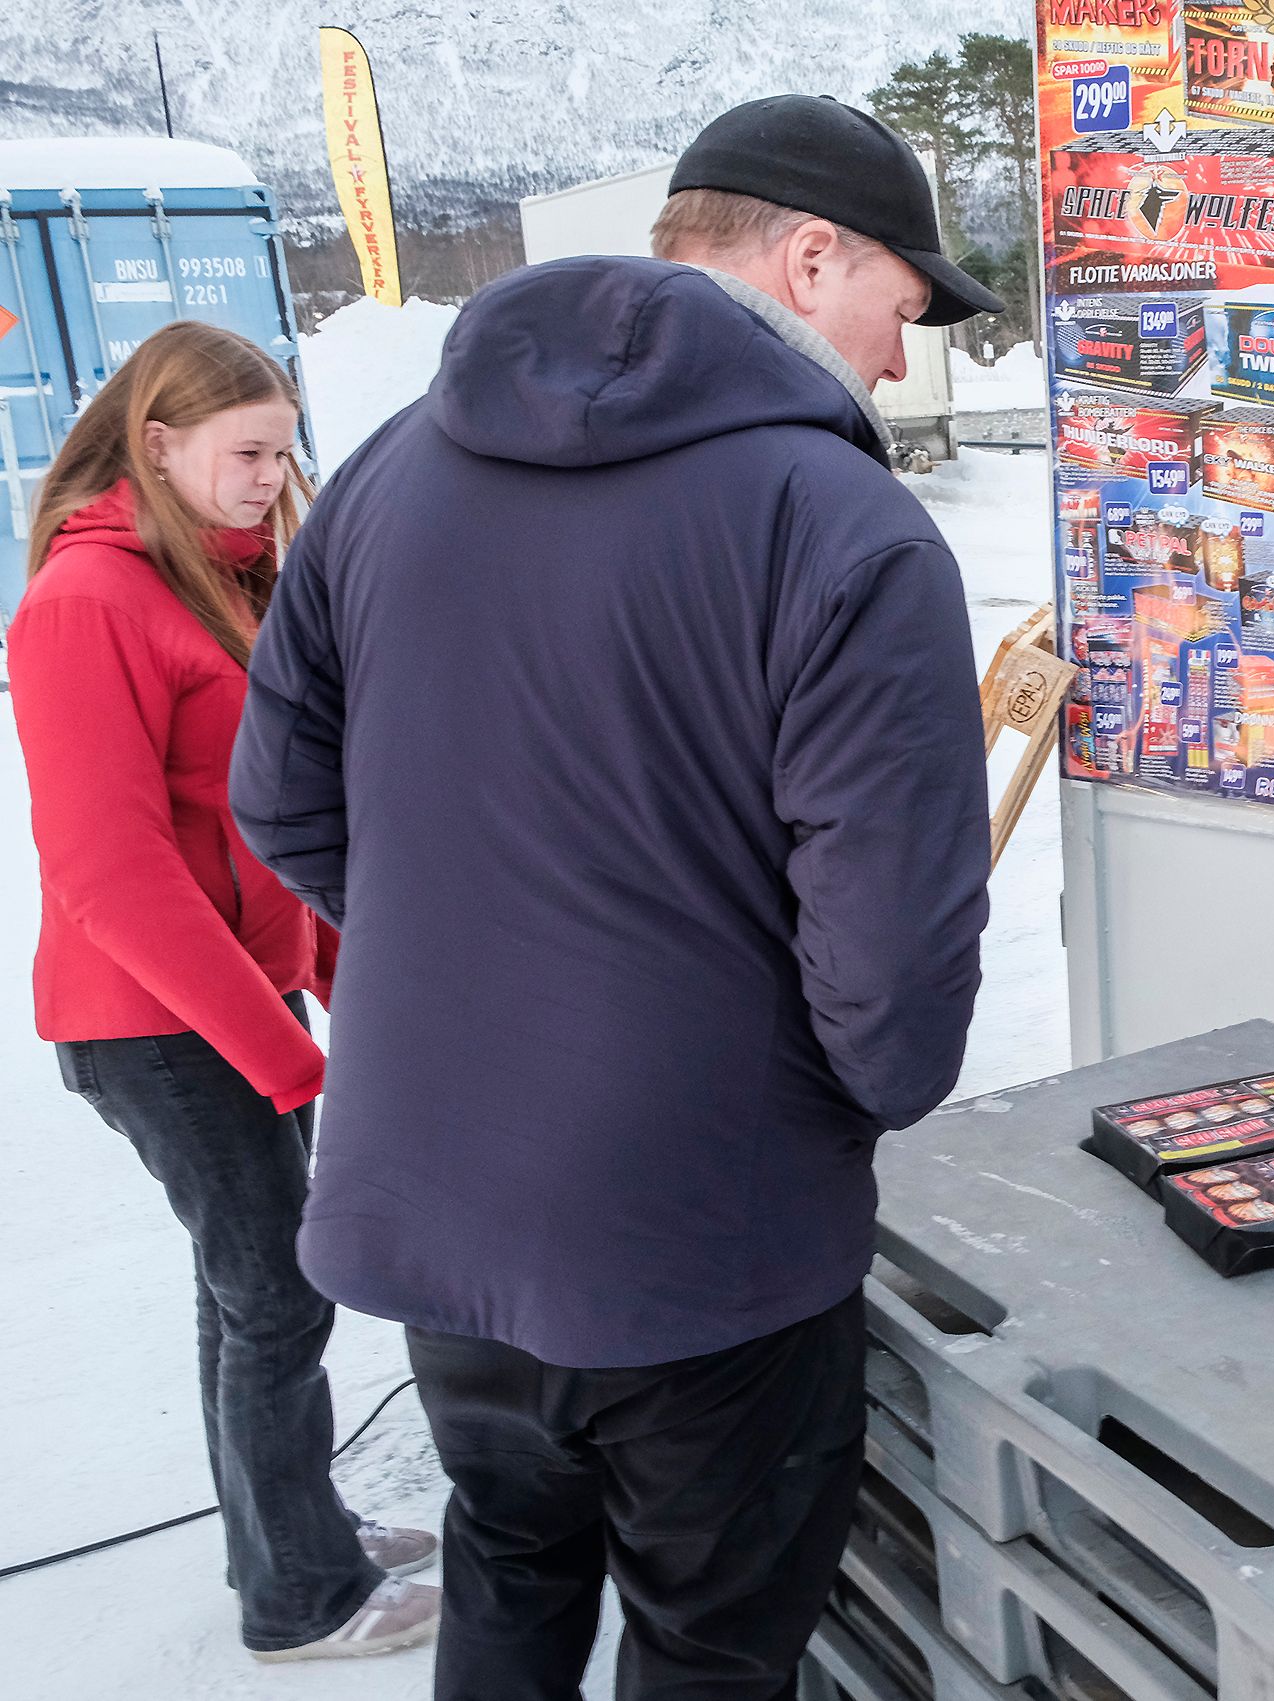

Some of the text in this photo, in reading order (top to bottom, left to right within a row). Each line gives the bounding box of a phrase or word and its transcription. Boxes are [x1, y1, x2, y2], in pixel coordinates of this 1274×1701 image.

[1054, 64, 1079, 77] SPAR
[343, 51, 385, 298] FESTIVAL FYRVERKERI
[1061, 186, 1132, 221] SPACE
[114, 258, 159, 280] BNSU
[178, 256, 247, 278] 993508
[1069, 261, 1218, 285] FLOTTE VARIASJONER
[183, 284, 229, 305] 22G1
[1076, 339, 1134, 361] GRAVITY
[1062, 424, 1179, 456] THUNDERLORD
[1203, 453, 1232, 467] SKY
[1125, 530, 1155, 547] PET
[1011, 682, 1043, 718] EPAL
